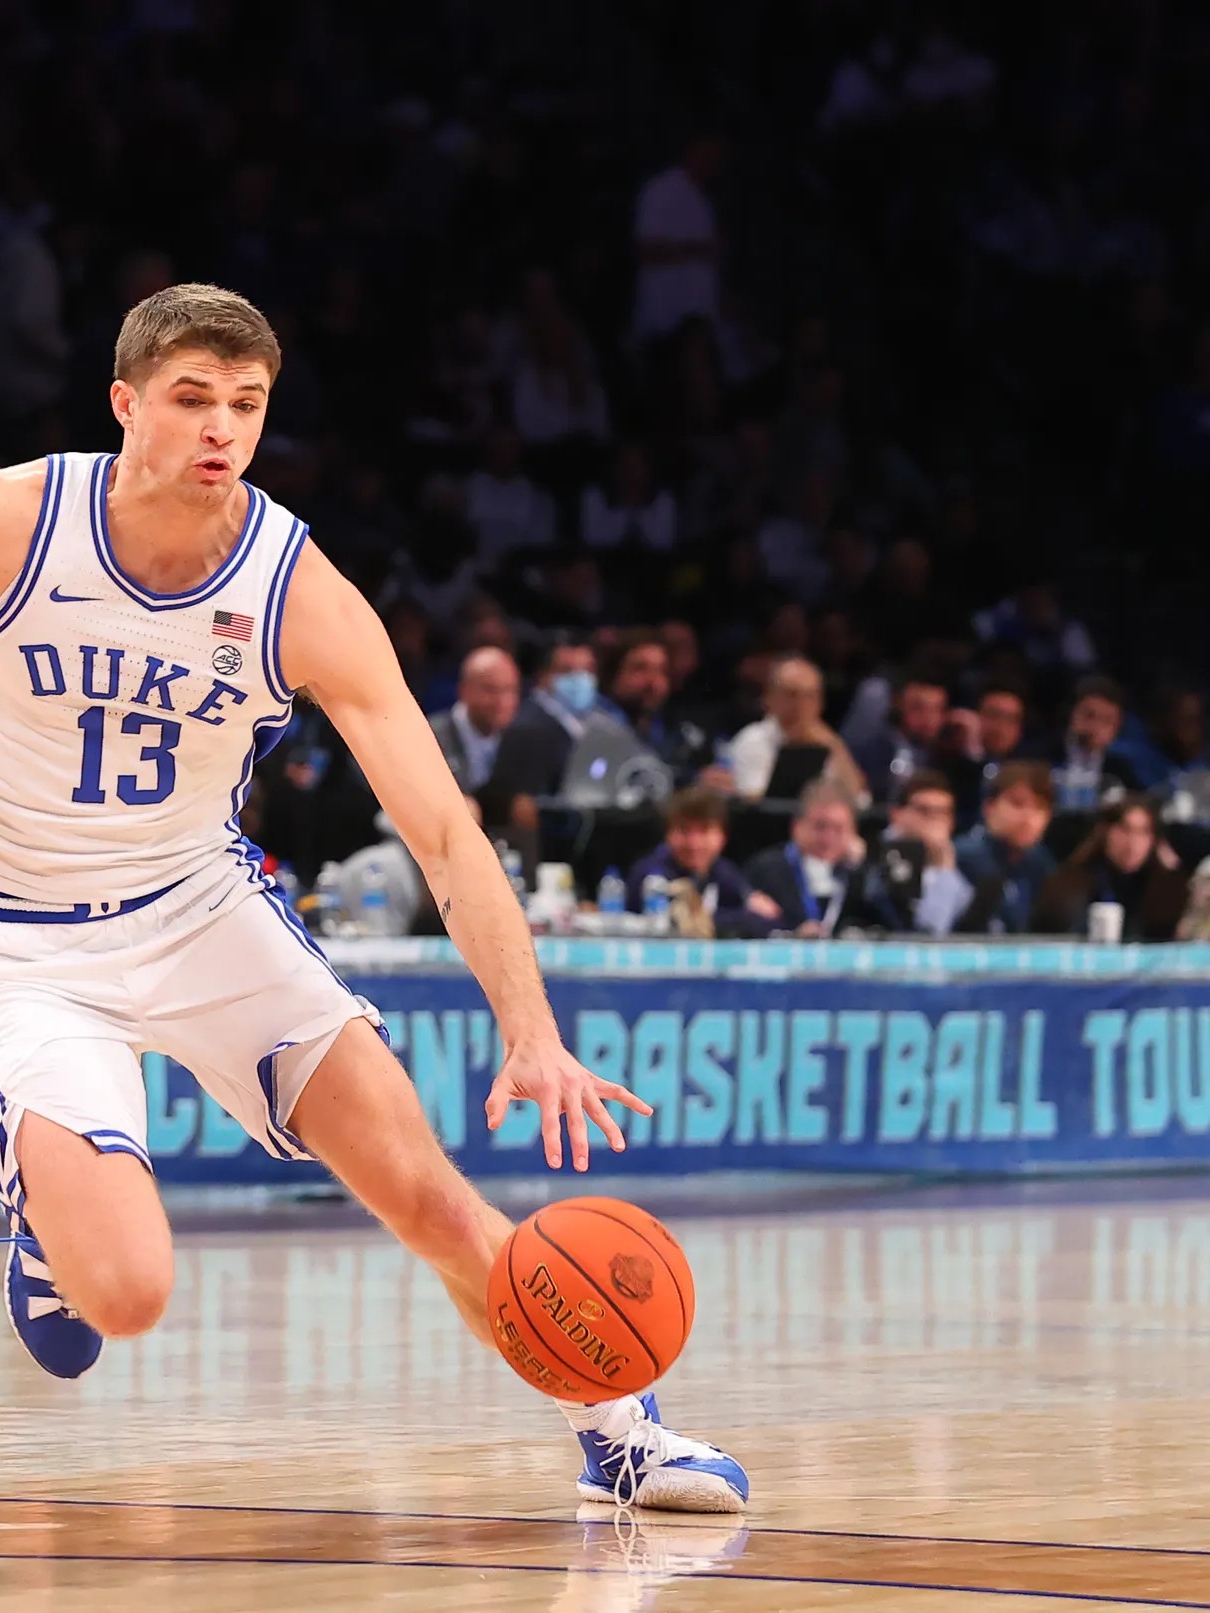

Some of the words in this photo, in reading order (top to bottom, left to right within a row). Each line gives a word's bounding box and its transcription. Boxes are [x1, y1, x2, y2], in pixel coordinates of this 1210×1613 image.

[19, 643, 248, 725] DUKE
[217, 654, 242, 667] ACC
[72, 706, 182, 805] 13
[576, 1009, 1057, 1147] BASKETBALL
[1083, 1006, 1210, 1139] TOU
[521, 1263, 631, 1380] SPALDING
